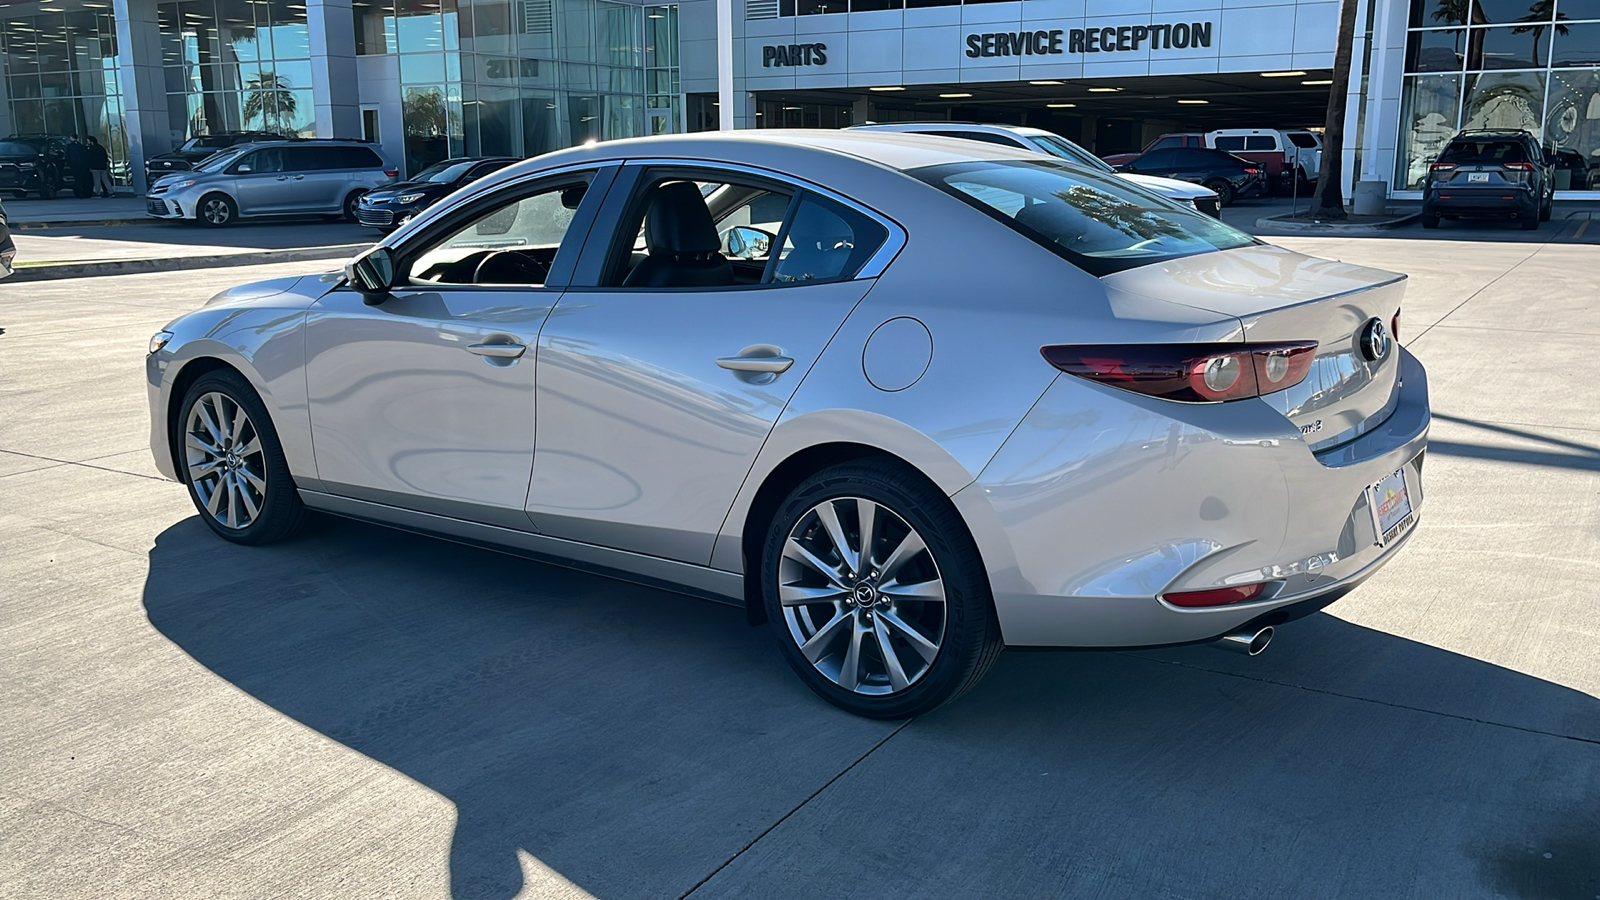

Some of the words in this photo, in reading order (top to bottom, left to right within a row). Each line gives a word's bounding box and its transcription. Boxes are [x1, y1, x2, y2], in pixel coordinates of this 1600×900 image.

[965, 30, 1062, 57] SERVICE
[1068, 22, 1212, 53] RECEPTION
[762, 43, 826, 67] PARTS
